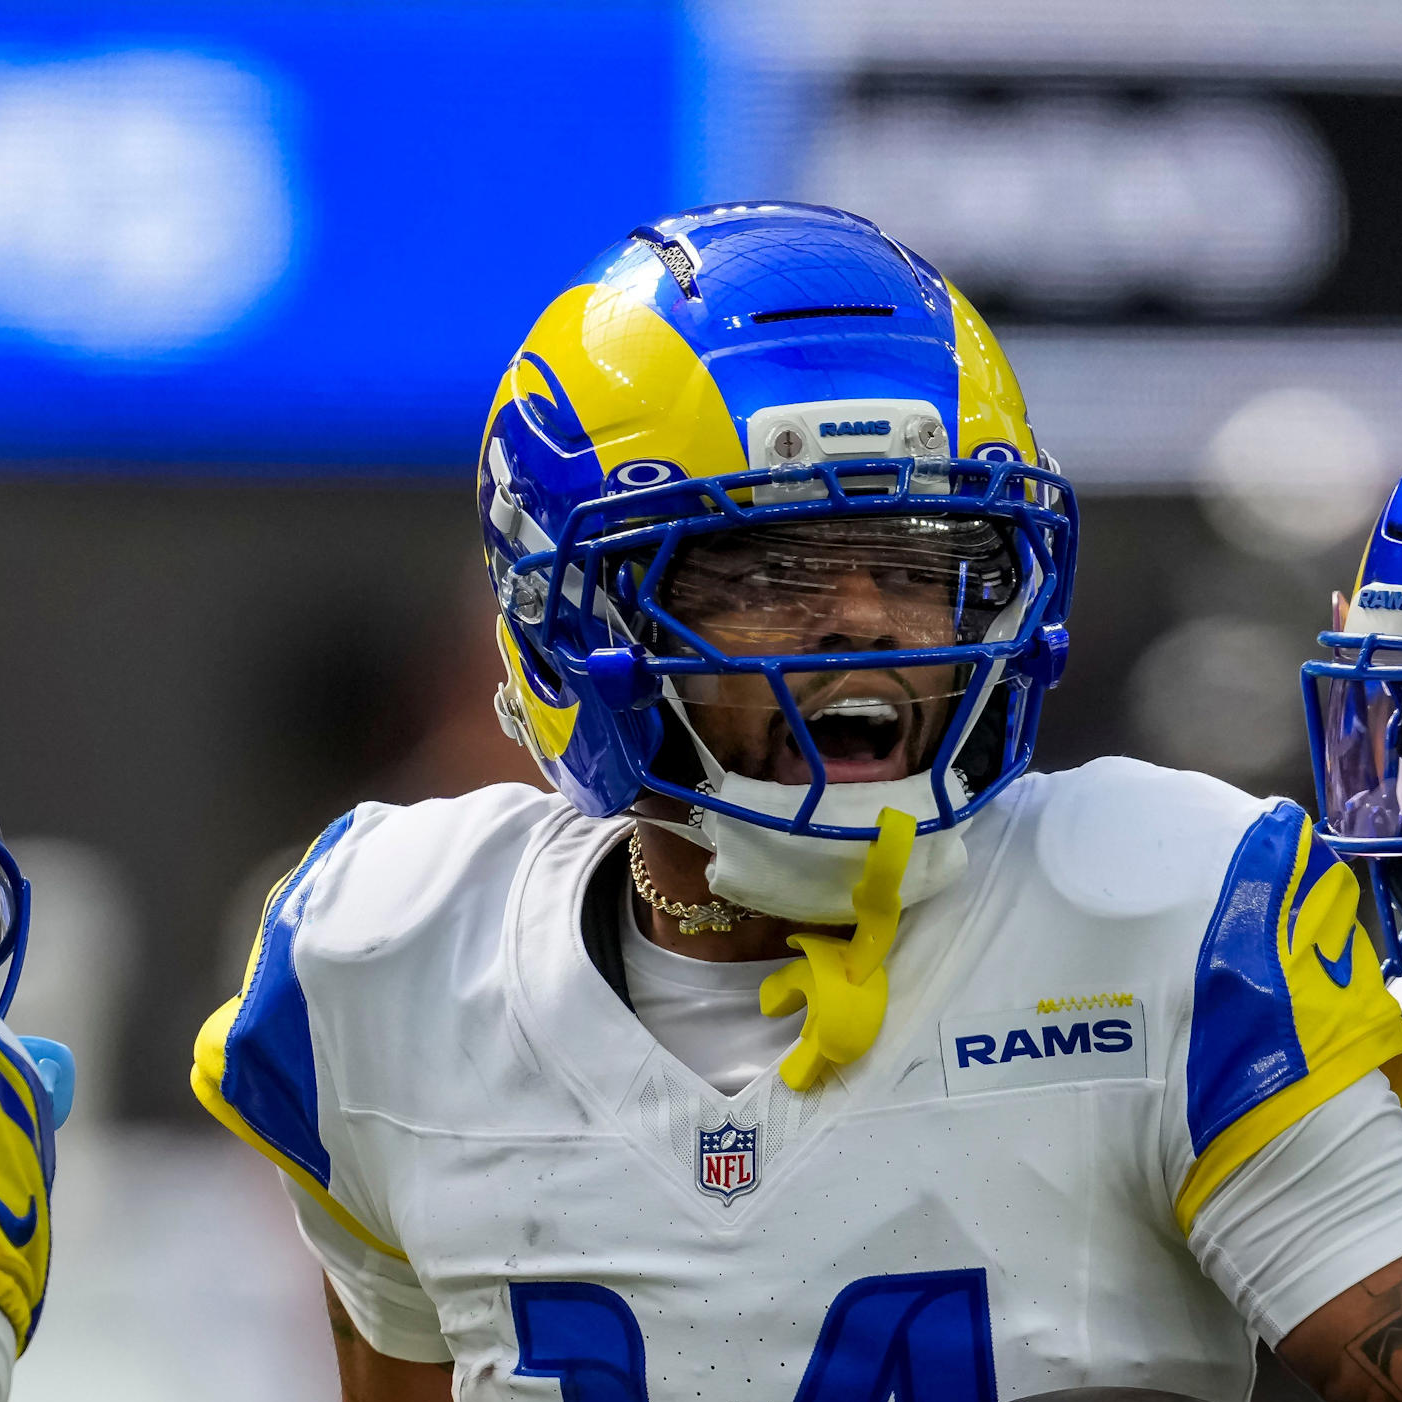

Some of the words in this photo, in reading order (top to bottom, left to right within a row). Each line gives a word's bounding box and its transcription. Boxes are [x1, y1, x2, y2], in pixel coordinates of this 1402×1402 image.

[818, 419, 892, 438] RAMS
[954, 1019, 1134, 1069] RAMS
[704, 1154, 752, 1189] NFL
